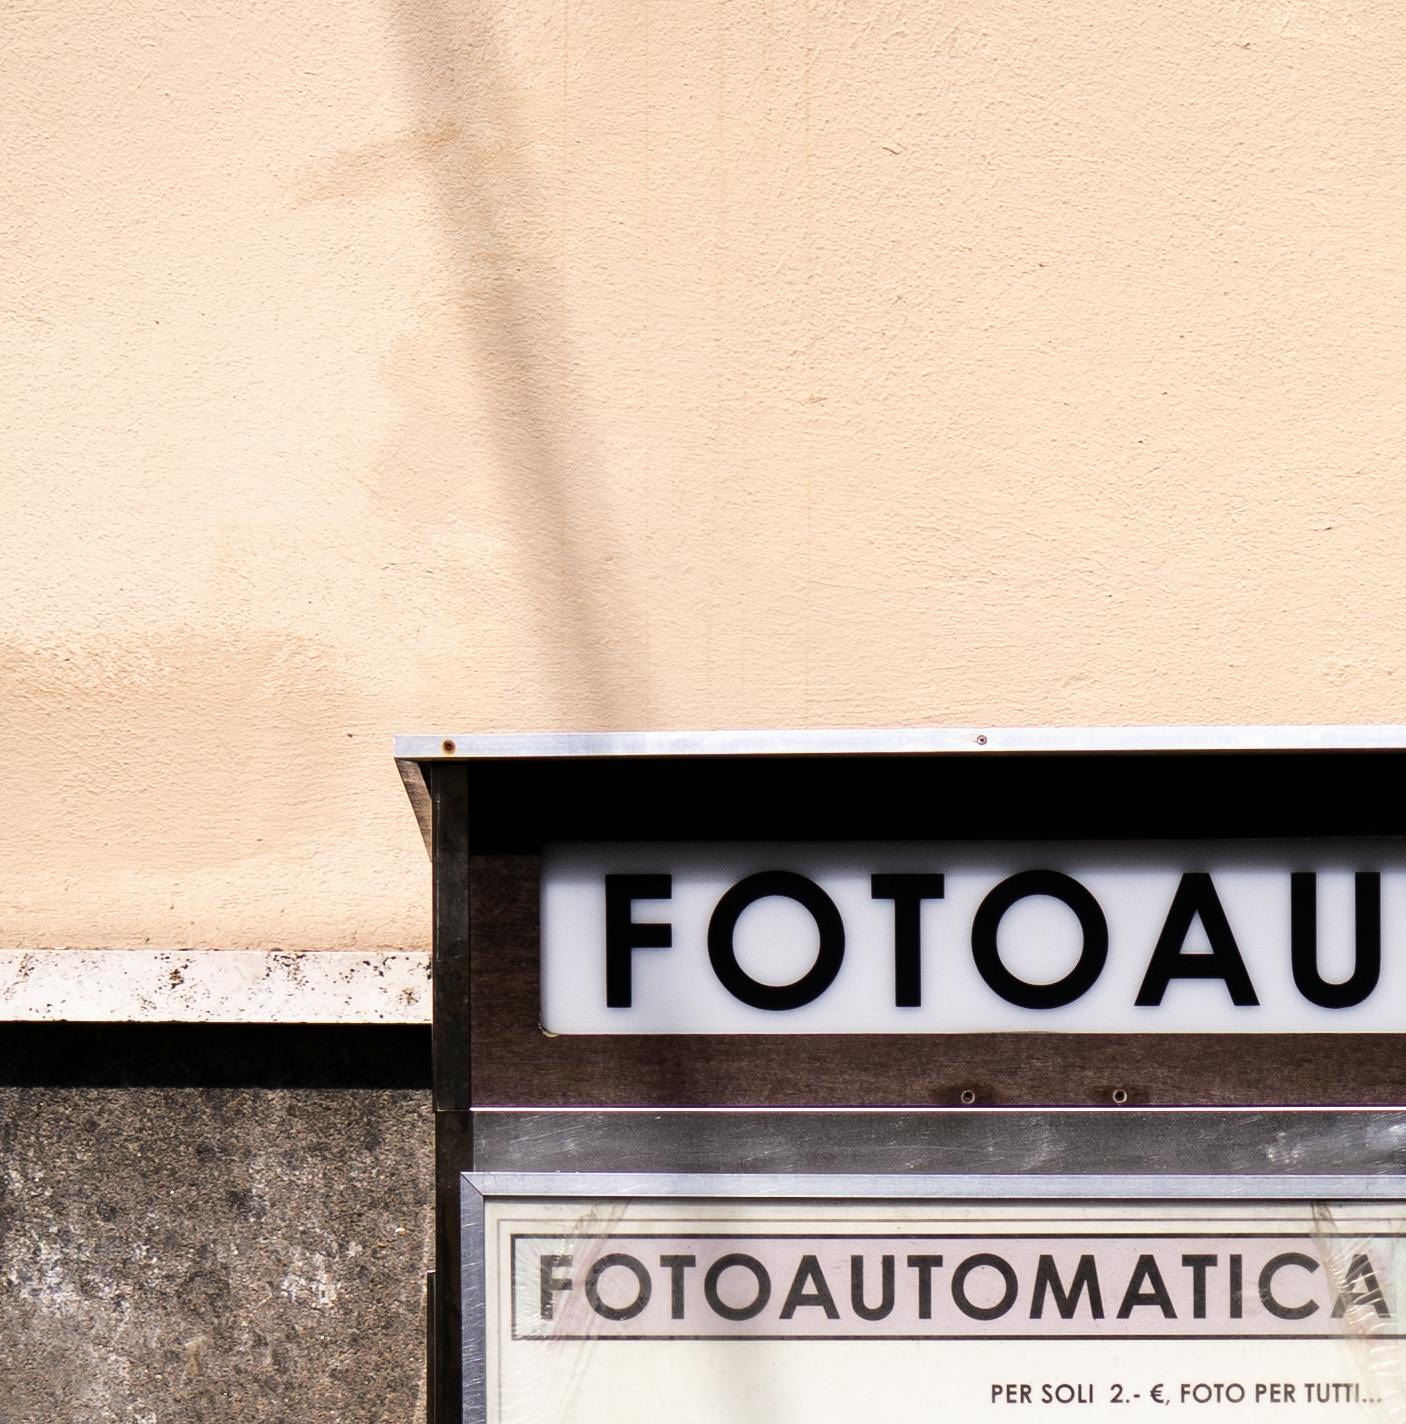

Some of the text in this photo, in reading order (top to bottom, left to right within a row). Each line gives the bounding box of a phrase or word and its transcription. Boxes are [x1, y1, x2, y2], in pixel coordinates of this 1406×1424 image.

[540, 1252, 1390, 1321] FOTOAUTOMATICA
[992, 1383, 1381, 1406] PER SOLI 2.- €, FOTO PER TUTTI...
